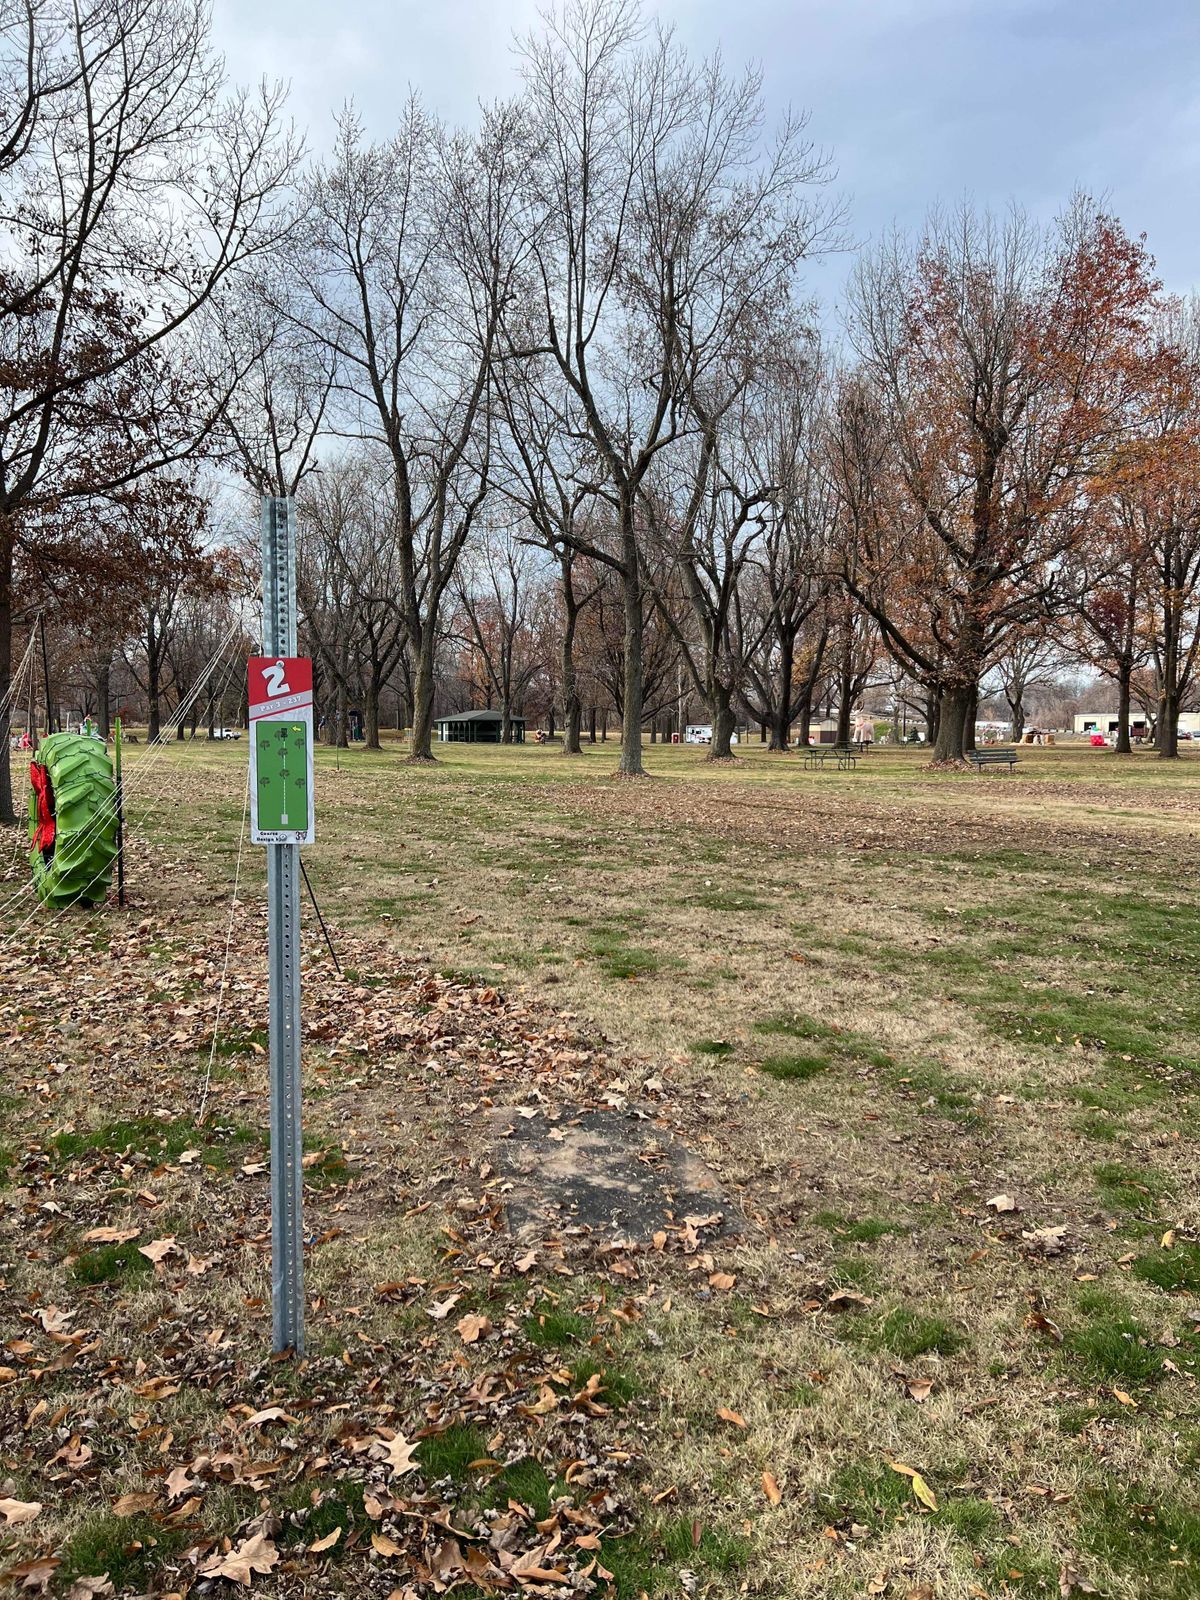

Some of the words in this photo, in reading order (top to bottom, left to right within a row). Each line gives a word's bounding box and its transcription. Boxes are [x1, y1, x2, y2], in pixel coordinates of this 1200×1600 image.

[261, 665, 290, 697] 2
[260, 704, 274, 712] Par
[288, 695, 301, 704] 237
